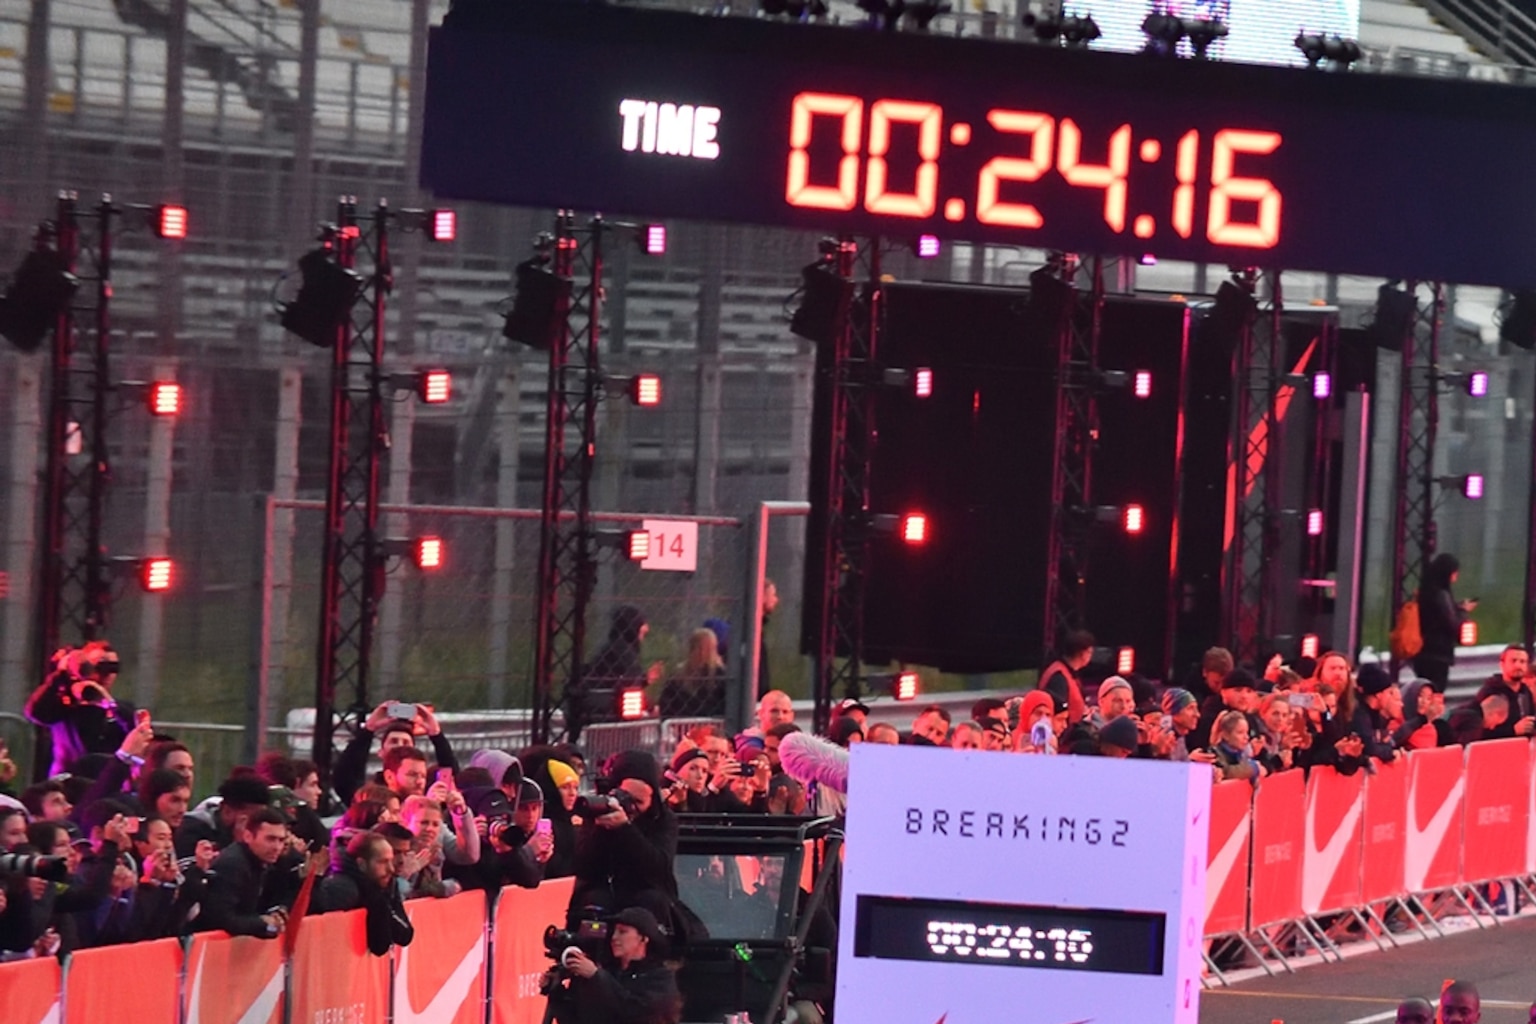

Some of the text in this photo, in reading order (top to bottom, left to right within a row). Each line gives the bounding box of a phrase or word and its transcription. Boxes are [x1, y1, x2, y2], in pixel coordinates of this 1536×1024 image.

[619, 98, 722, 160] TIME
[786, 91, 1283, 248] 00:24:16
[655, 533, 684, 558] 14
[905, 807, 1130, 847] BREAKING2
